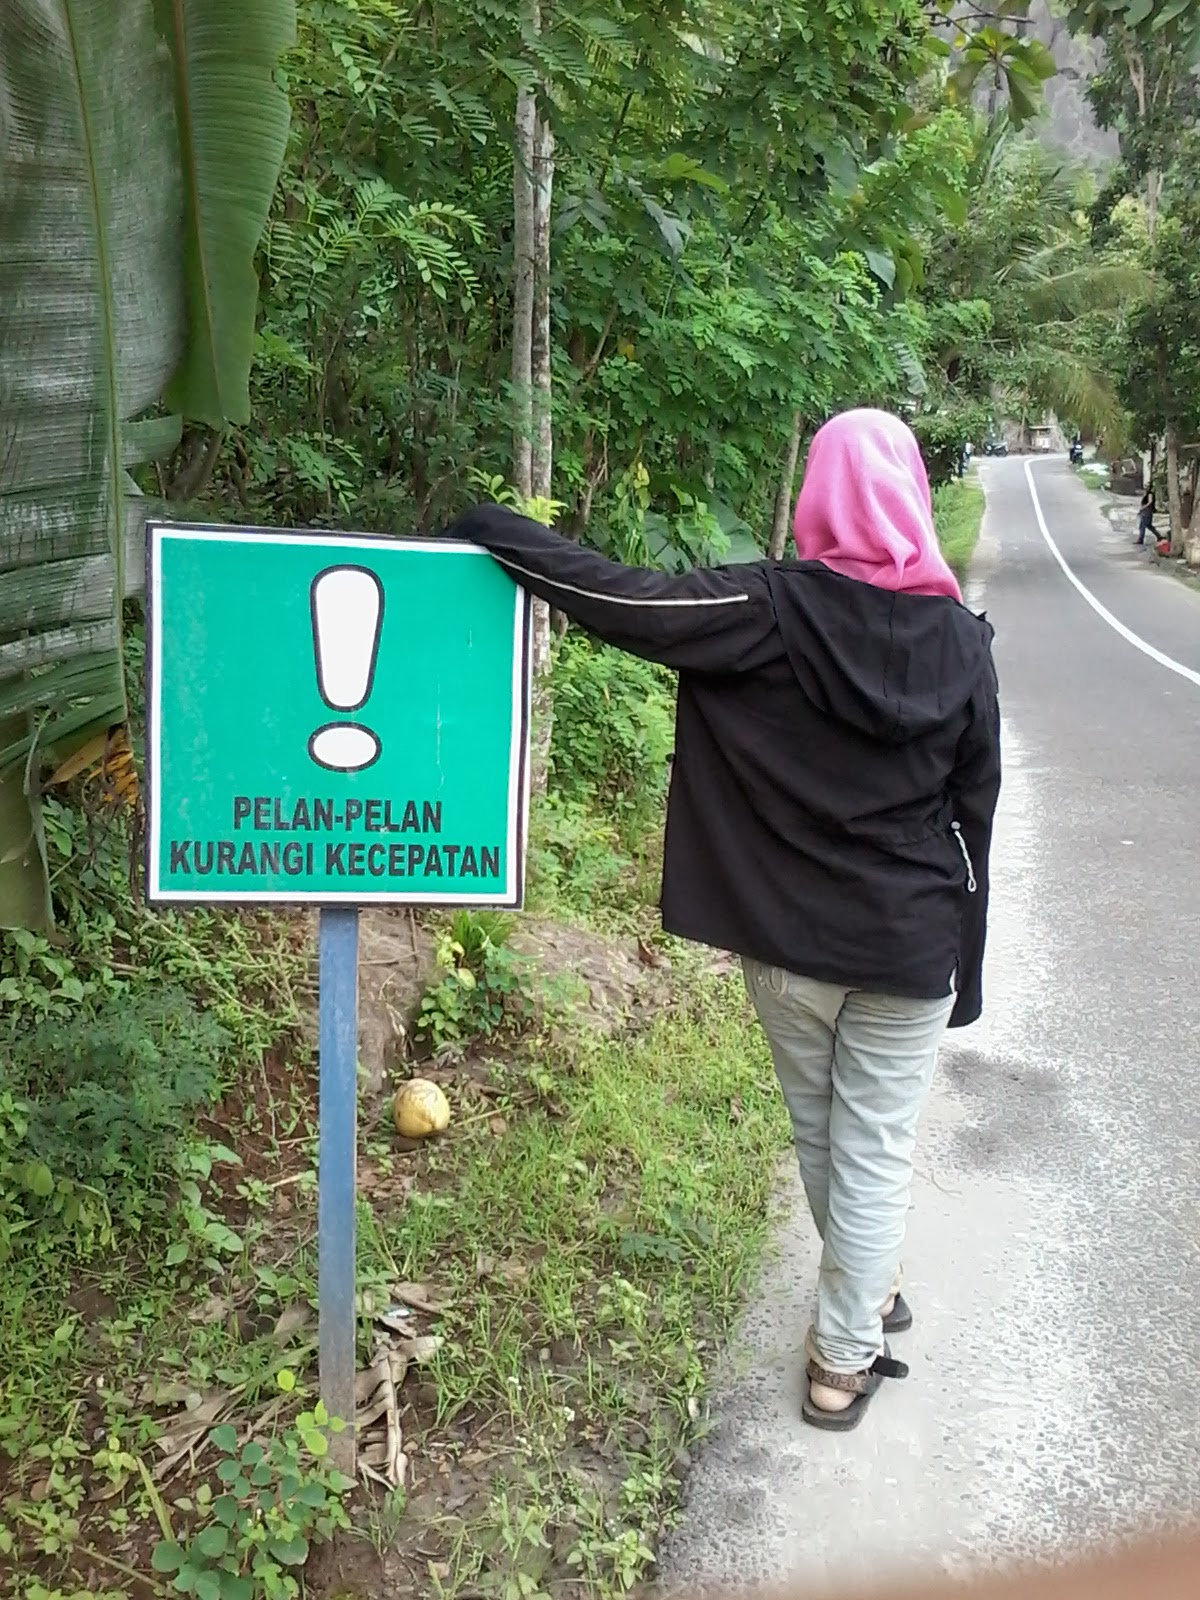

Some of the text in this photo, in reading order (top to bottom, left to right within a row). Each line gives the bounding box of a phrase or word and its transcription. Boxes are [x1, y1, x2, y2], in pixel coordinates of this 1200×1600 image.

[233, 796, 442, 833] PELAN-PELAN
[169, 840, 500, 878] KURANGI KECEPATAN
